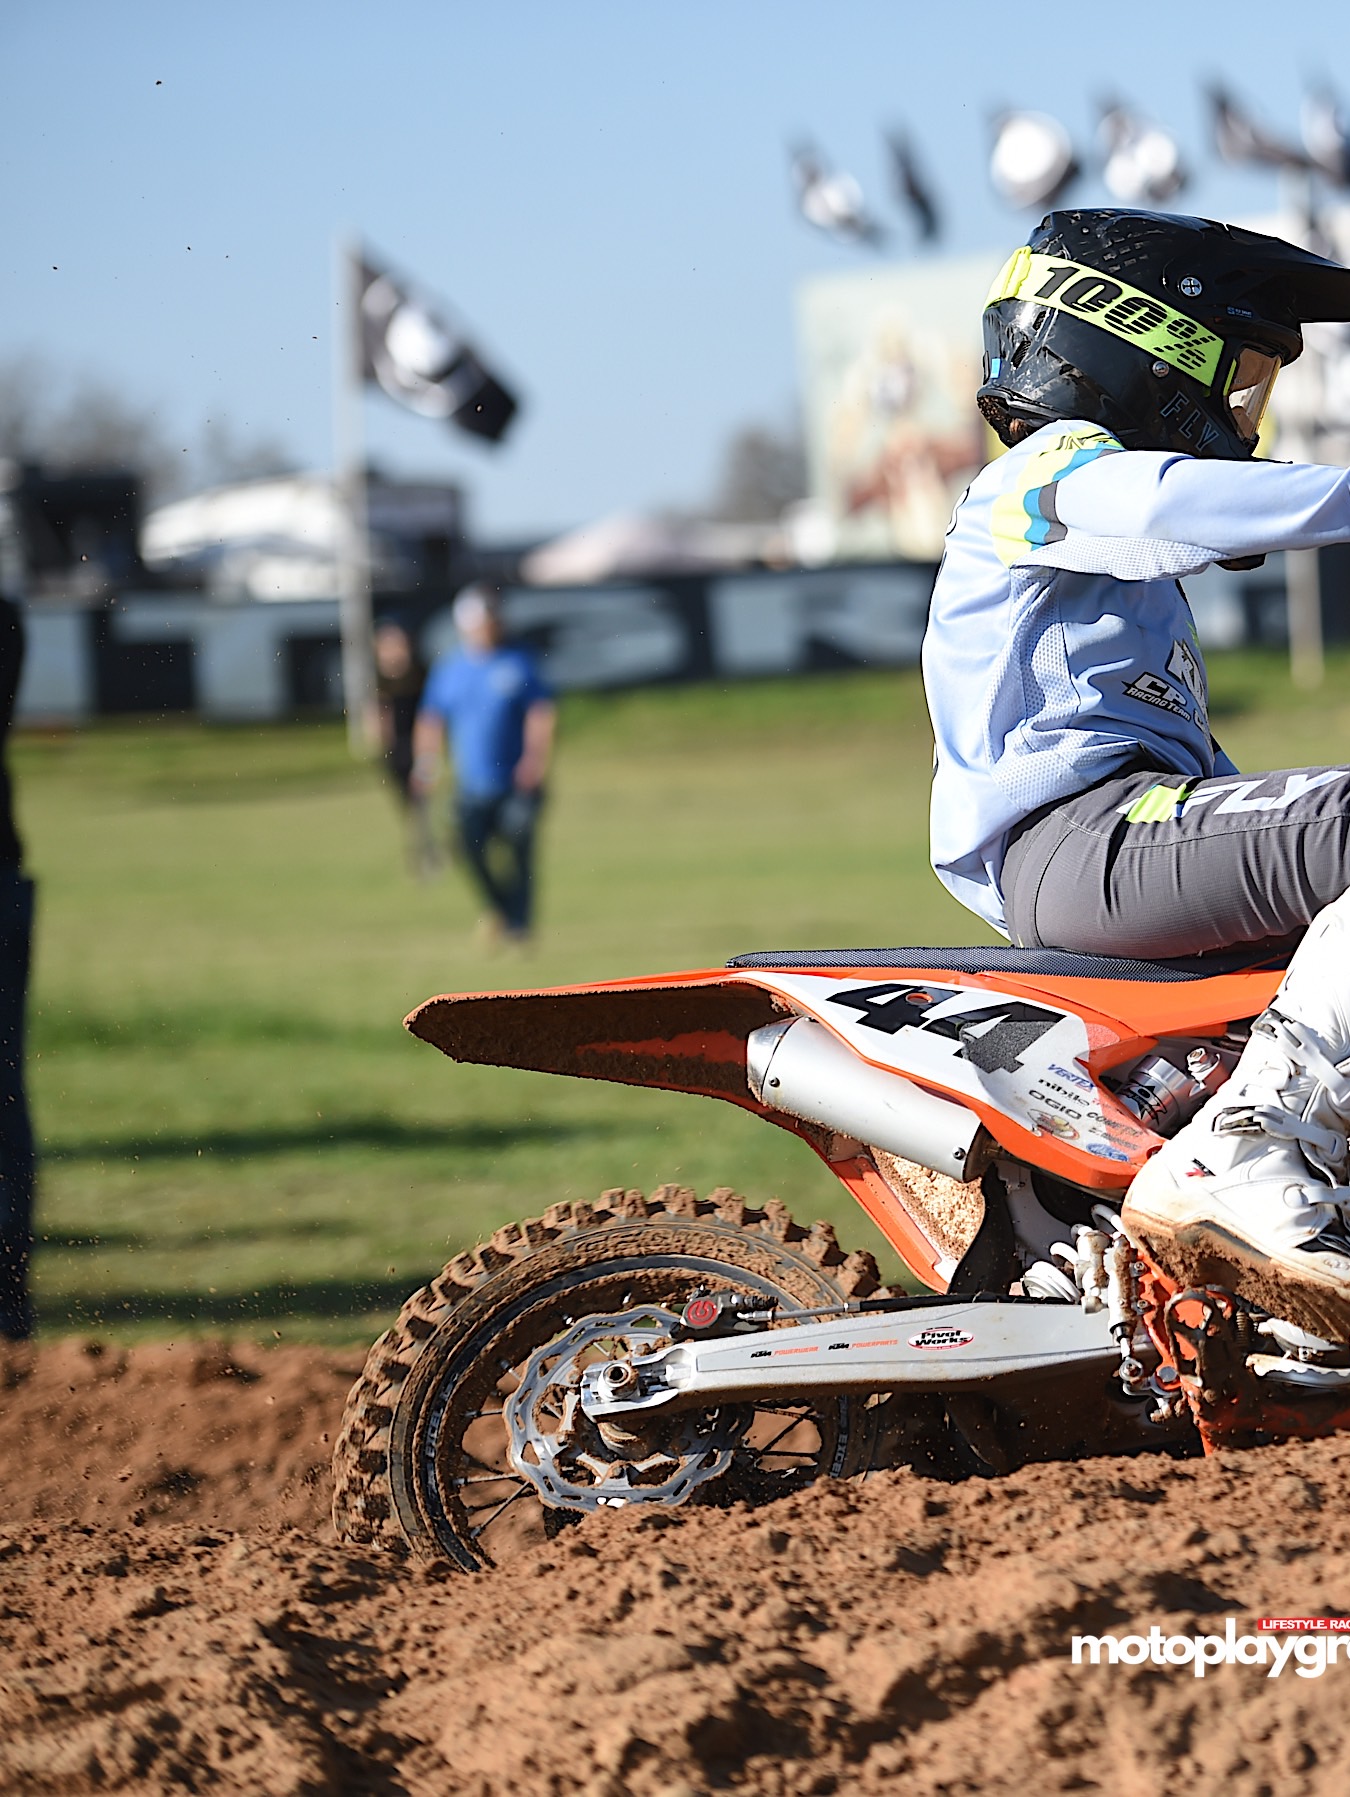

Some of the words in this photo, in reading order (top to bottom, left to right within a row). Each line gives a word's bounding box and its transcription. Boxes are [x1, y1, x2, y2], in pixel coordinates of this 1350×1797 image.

[1034, 265, 1217, 371] 100%
[1160, 390, 1220, 452] FLY
[1126, 687, 1168, 708] RACING
[1166, 701, 1191, 720] TEAM
[826, 983, 1067, 1073] 44
[1047, 1063, 1096, 1089] VERTEX
[1028, 1089, 1082, 1120] OGIO
[827, 1342, 850, 1350] KTM
[915, 1337, 970, 1346] Works
[921, 1330, 961, 1339] Pivot
[750, 1350, 772, 1358] KTM
